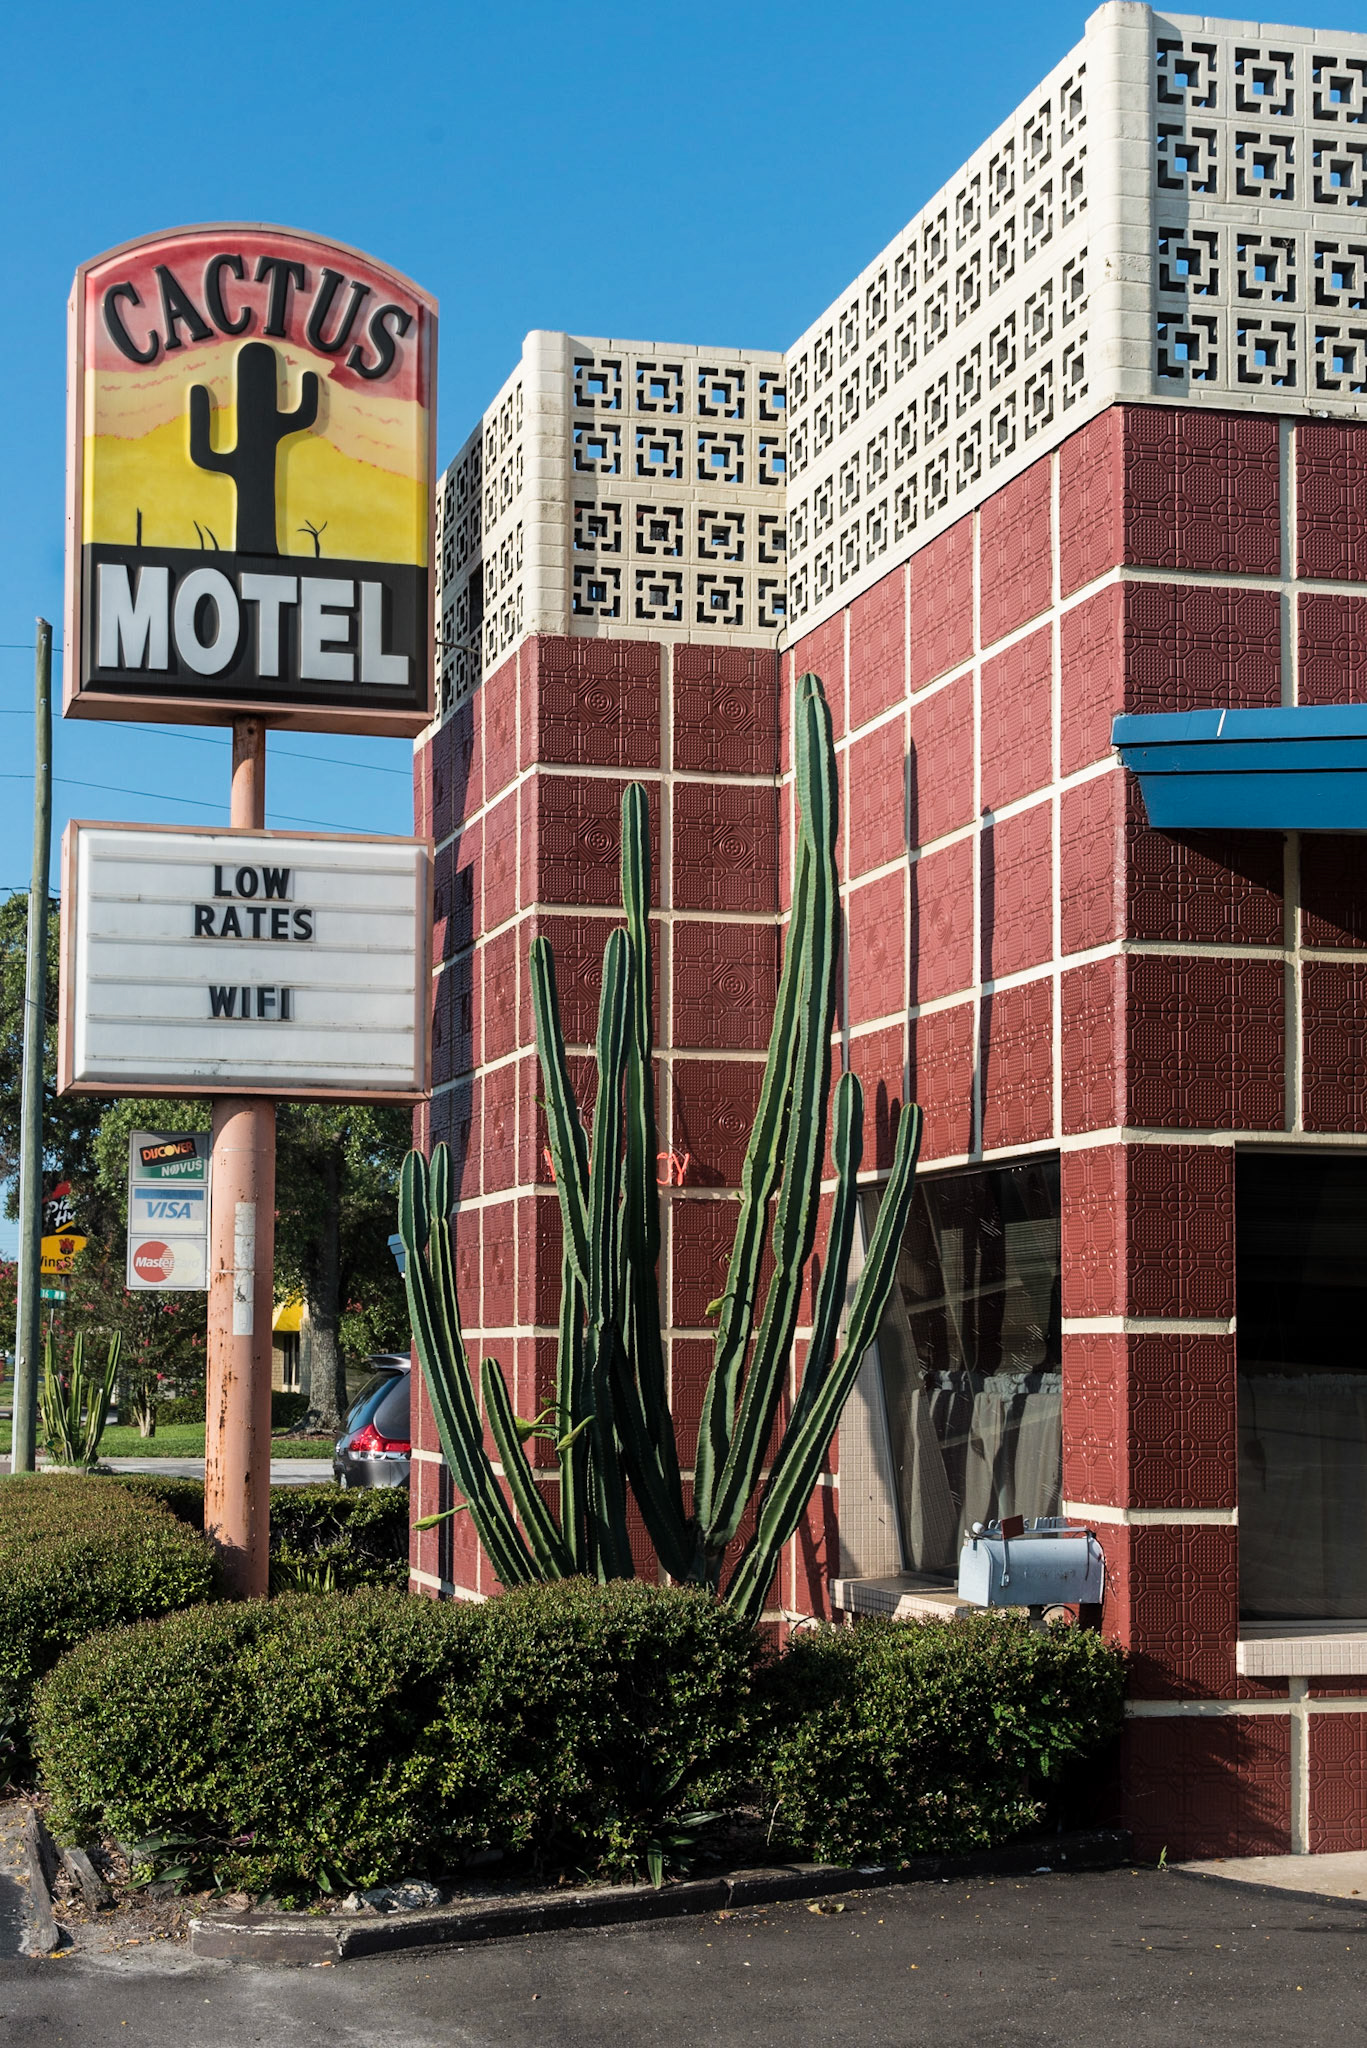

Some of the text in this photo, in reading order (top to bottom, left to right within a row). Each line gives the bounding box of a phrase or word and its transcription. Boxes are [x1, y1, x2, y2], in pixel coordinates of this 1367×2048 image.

[101, 253, 413, 380] CACTUS
[98, 563, 410, 686] MOTEL
[213, 864, 291, 900] LOW
[194, 904, 313, 941] RATES
[209, 985, 291, 1020] WIFI
[142, 1141, 194, 1160] DISCOVER
[147, 1201, 191, 1218] VISA
